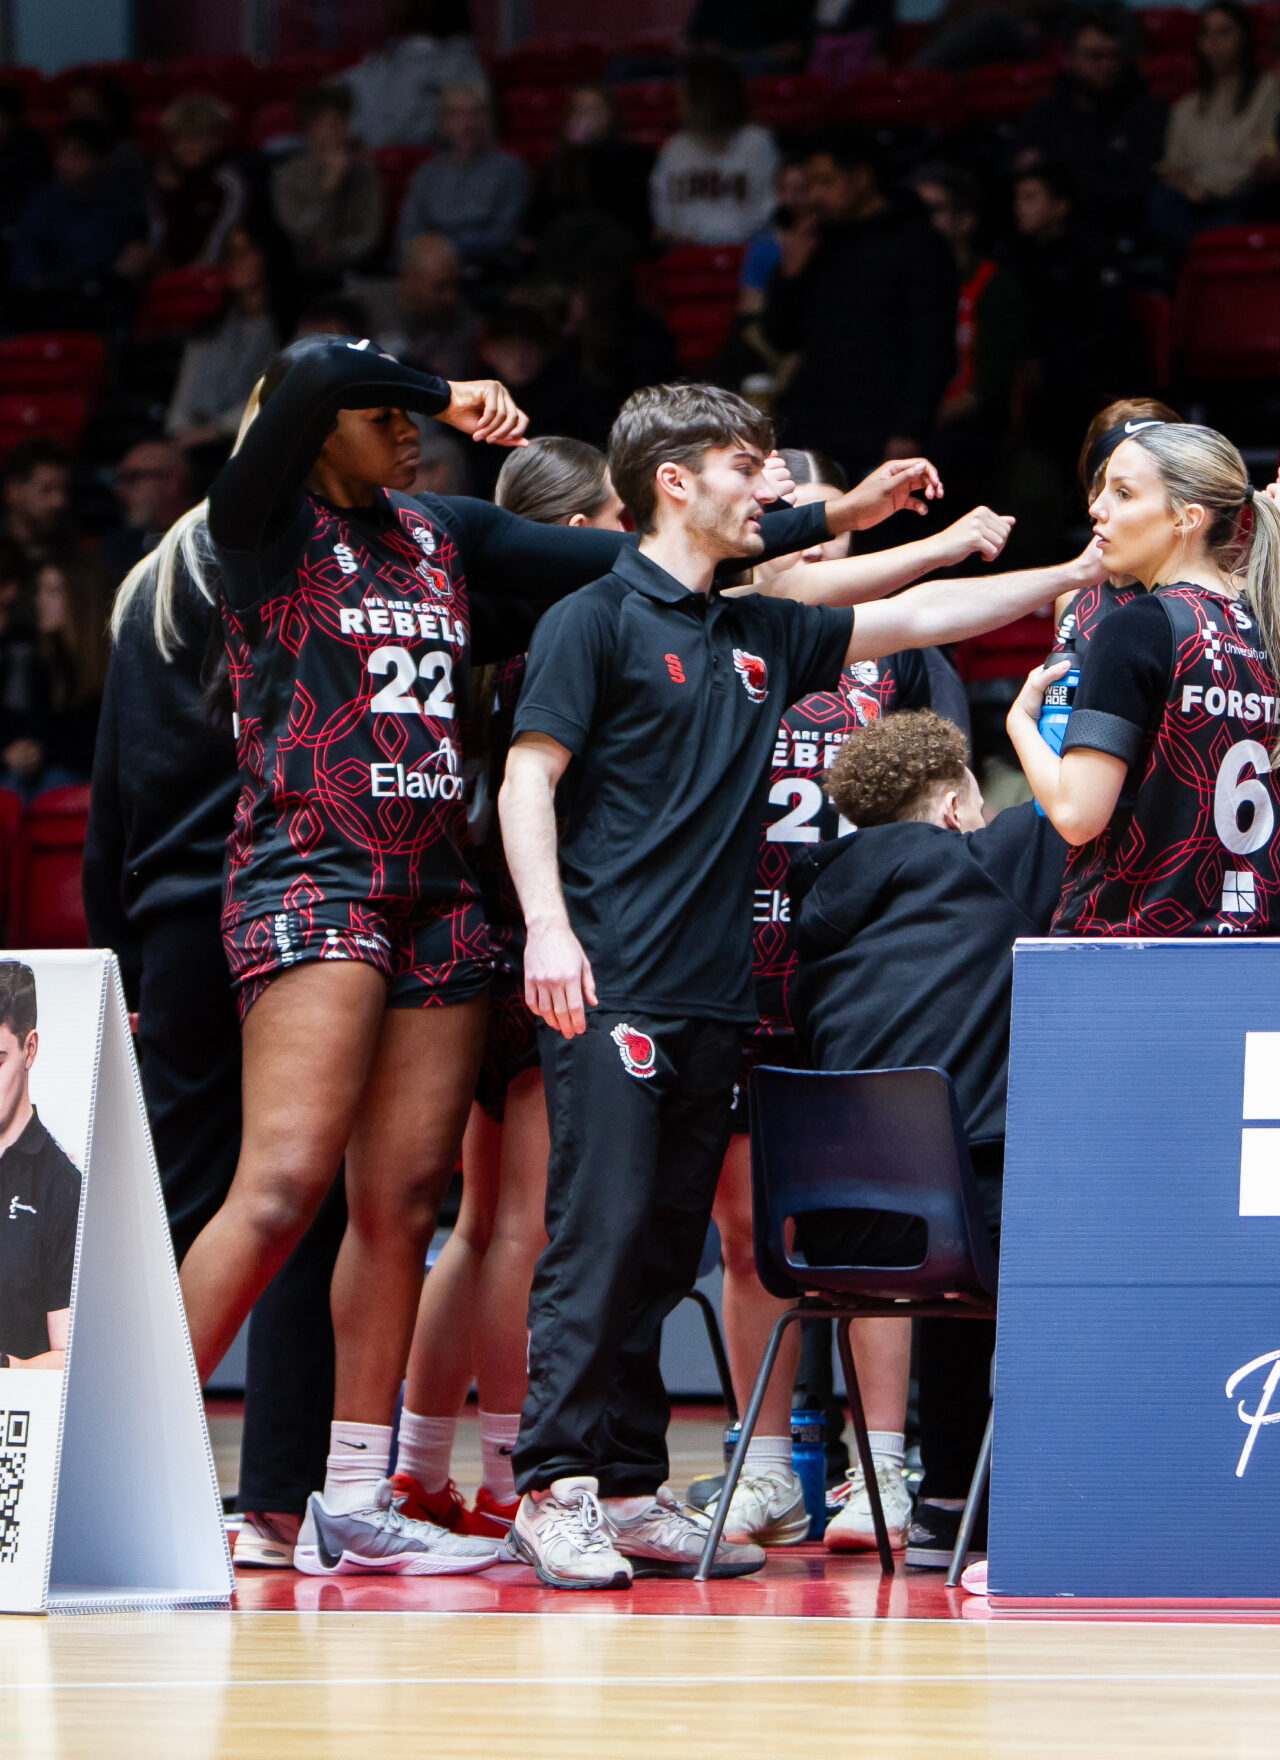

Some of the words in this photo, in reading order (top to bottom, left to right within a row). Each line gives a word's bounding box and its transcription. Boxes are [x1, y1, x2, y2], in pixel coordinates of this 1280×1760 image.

[340, 608, 466, 648] REBELS
[368, 646, 455, 720] 22
[791, 730, 819, 741] ARE
[1214, 739, 1275, 855] 6
